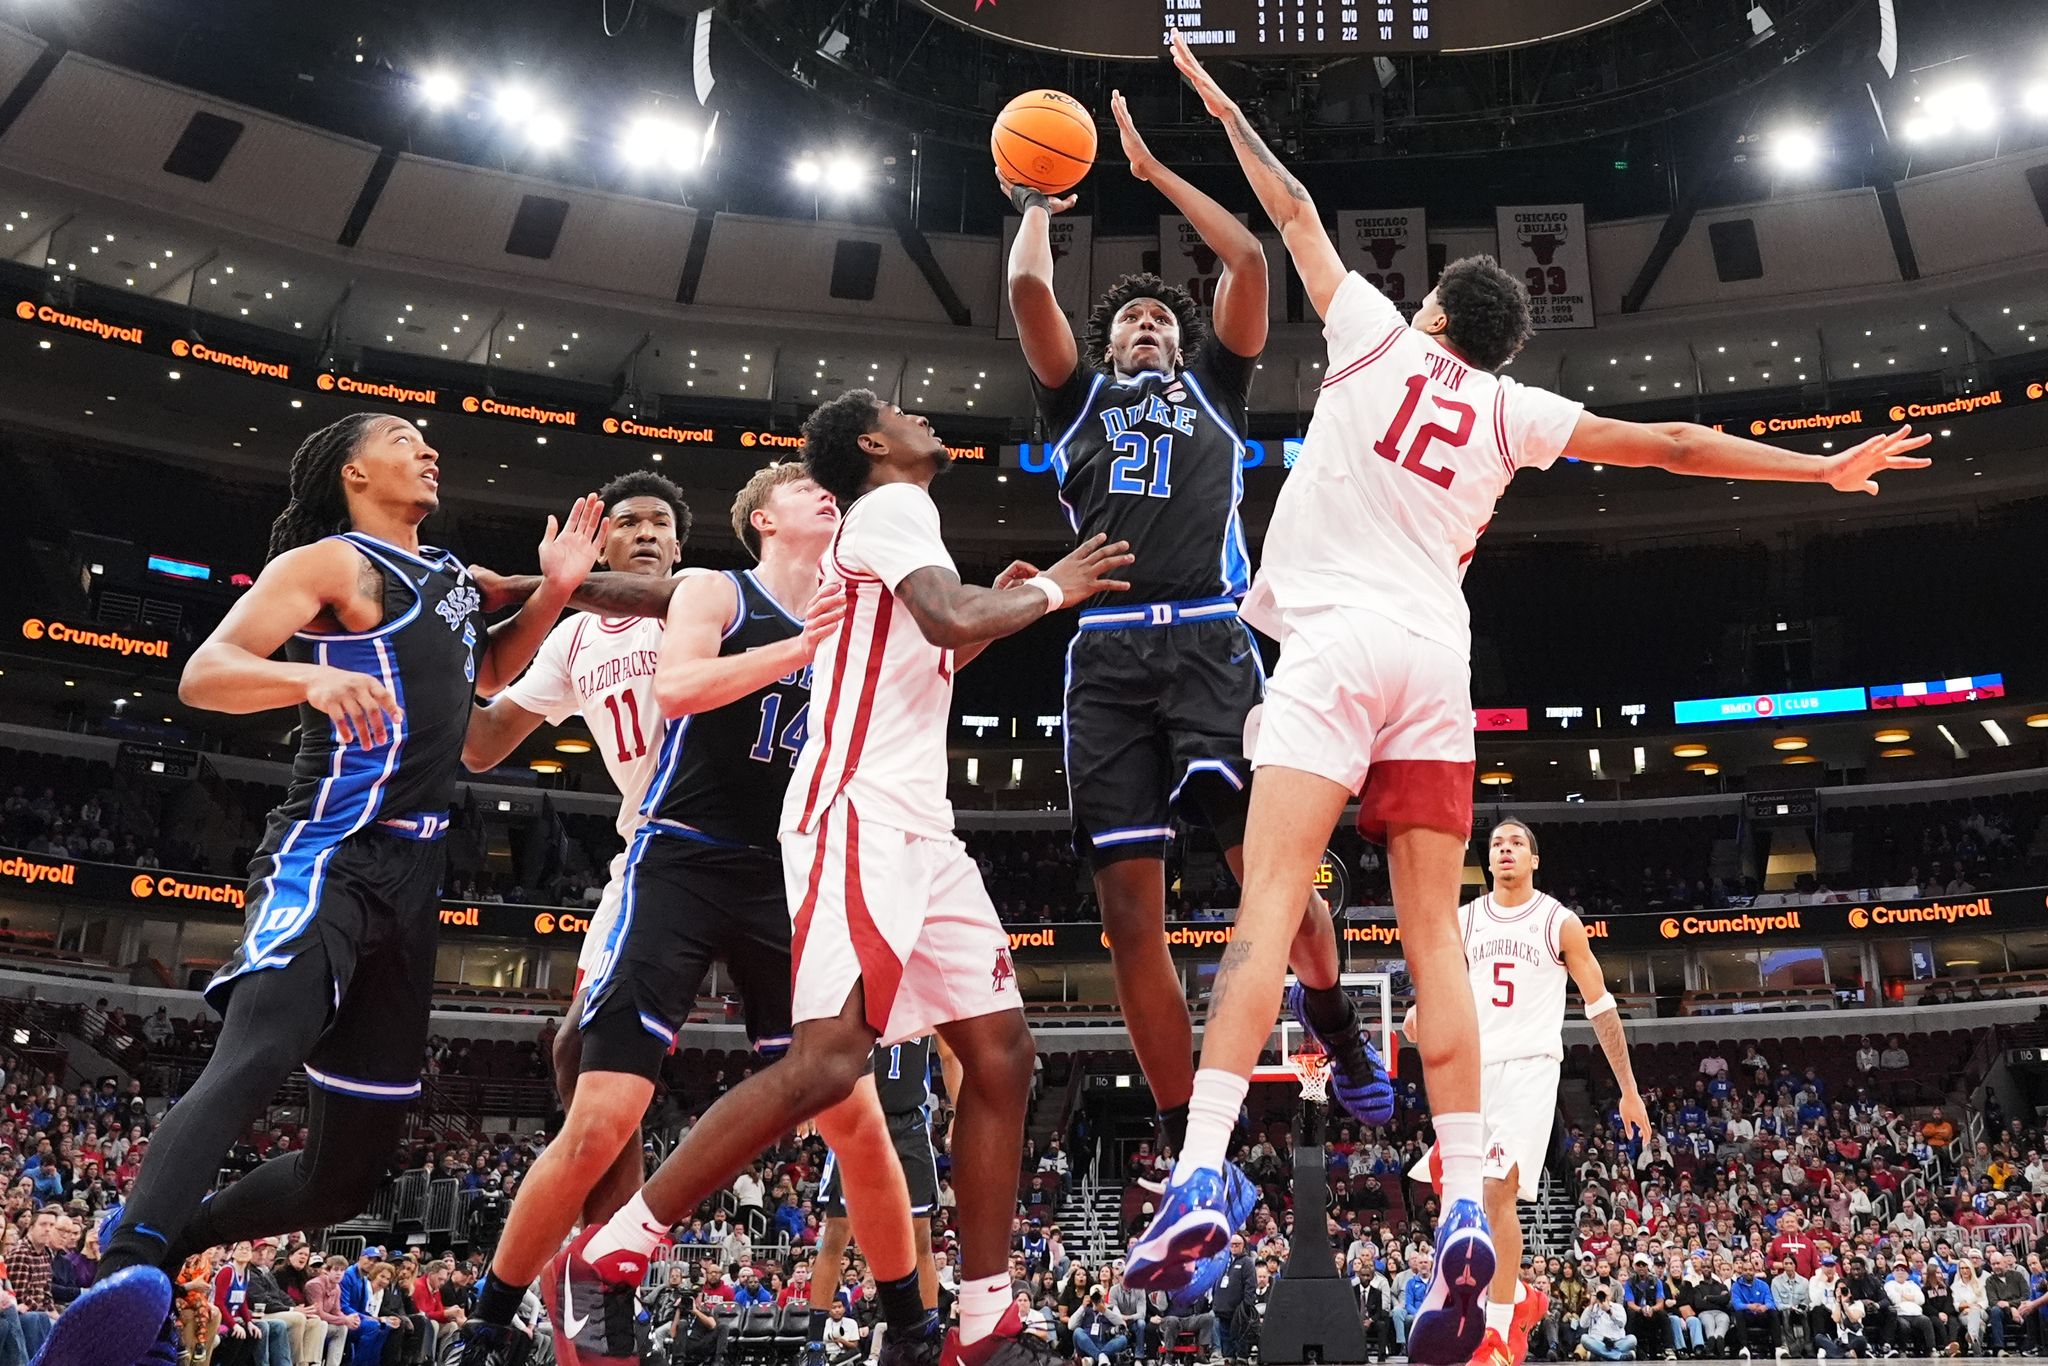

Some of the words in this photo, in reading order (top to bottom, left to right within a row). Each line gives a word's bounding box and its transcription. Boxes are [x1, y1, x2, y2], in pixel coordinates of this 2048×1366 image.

[1165, 14, 1175, 27] 12
[1178, 14, 1201, 27] EWIN
[1258, 12, 1266, 25] 3
[1297, 11, 1304, 24] 0
[1317, 10, 1324, 24] 0
[1341, 9, 1358, 23] 0/0
[1377, 9, 1394, 22] 0/0
[1412, 8, 1429, 22] 0/0
[1179, 30, 1224, 44] ICHMOND
[1259, 29, 1266, 42] 3
[1298, 28, 1305, 42] 5
[1317, 28, 1324, 41] 0
[1342, 27, 1358, 41] 2/2
[1380, 26, 1392, 40] 1/1
[1412, 25, 1429, 39] 0/0
[1355, 217, 1408, 227] CHICAGO
[1515, 213, 1568, 222] CHICAGO
[1523, 223, 1561, 233] BULLS
[1364, 228, 1402, 237] BULLS
[1525, 266, 1567, 296] 33
[1551, 295, 1584, 304] PIPPEN
[37, 306, 142, 343] Crunchyroll
[191, 344, 289, 379] Crunchyroll
[337, 377, 436, 404] Crunchyroll
[1907, 390, 2002, 417] Crunchyroll
[481, 399, 576, 426] Crunchyroll
[1100, 394, 1197, 441] DUKE
[1768, 410, 1862, 432] Crunchyroll
[621, 420, 713, 442] Crunchyroll
[1373, 374, 1477, 490] 12
[1108, 431, 1173, 498] 21
[48, 622, 169, 658] Crunchyroll
[1721, 703, 1751, 714] BMO
[1785, 697, 1820, 710] CLUB
[604, 688, 647, 763] 11
[749, 692, 810, 769] 14
[157, 877, 245, 909] Crunchy
[1682, 911, 1801, 935] Crunchyroll
[1871, 898, 1992, 924] Crunchyroll
[1472, 939, 1540, 967] RAZORBACKS
[1492, 962, 1515, 1008] 5
[888, 1044, 902, 1080] 1
